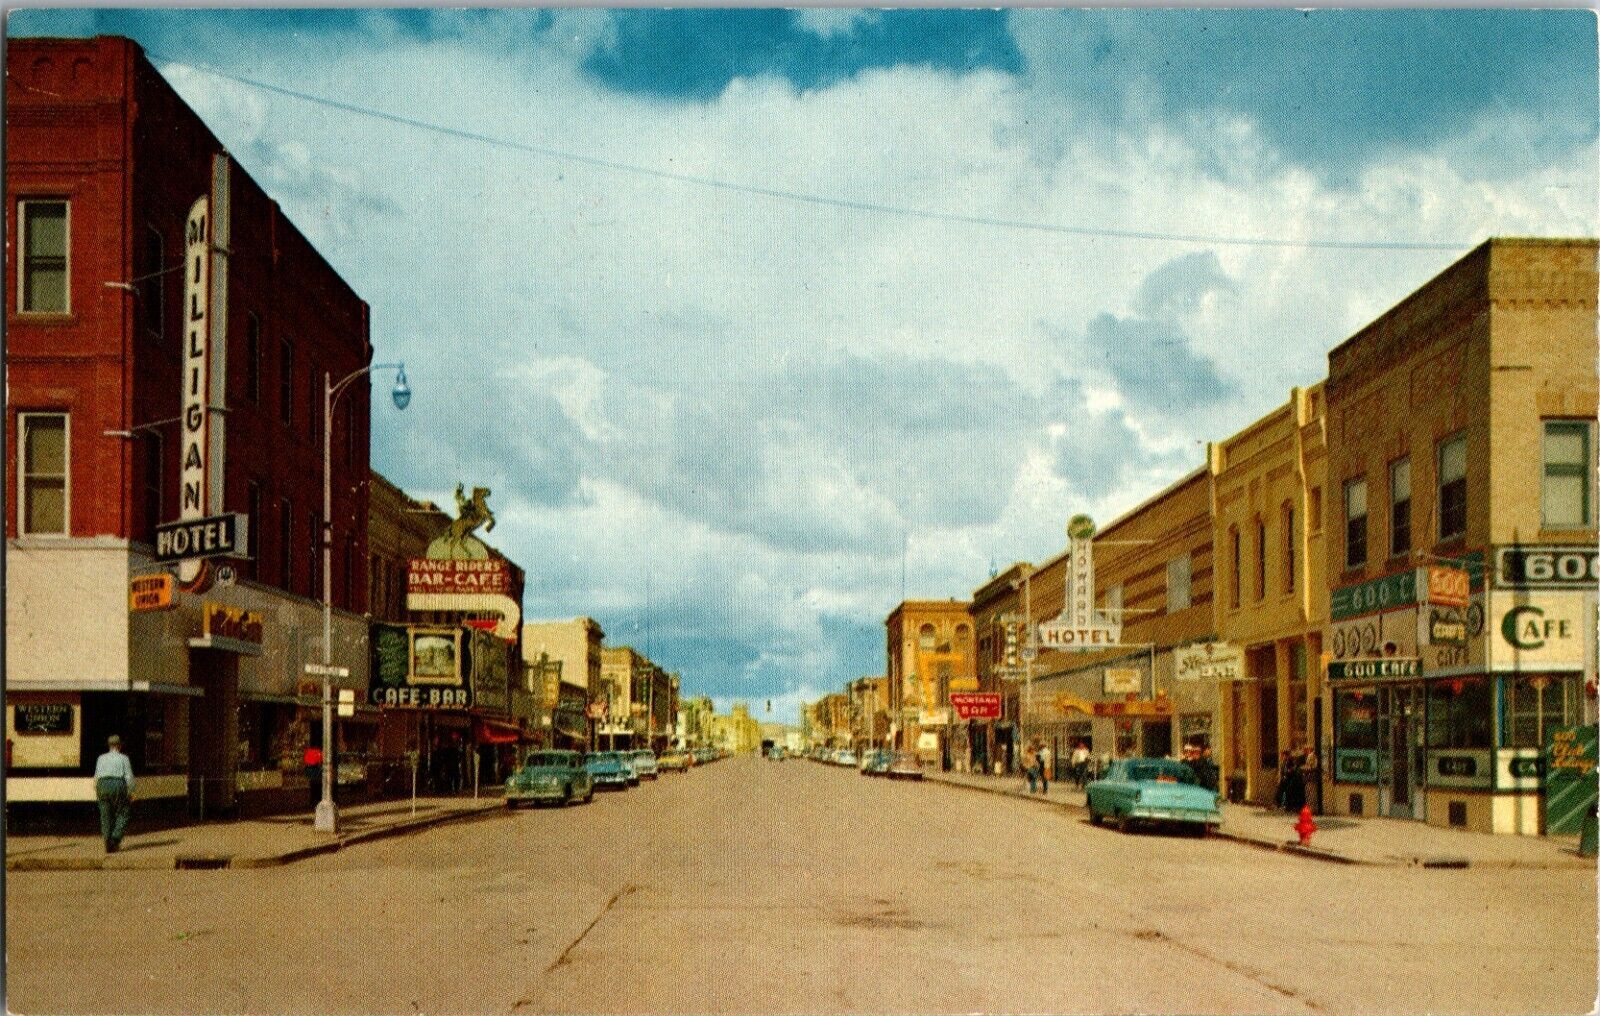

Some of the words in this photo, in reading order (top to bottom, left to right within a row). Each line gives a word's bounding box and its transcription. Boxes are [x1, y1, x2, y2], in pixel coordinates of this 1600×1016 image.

[184, 214, 206, 511] MILLIGAN
[157, 521, 231, 556] HOTEL
[411, 561, 452, 571] RANGE
[456, 561, 500, 571] RIDERS
[1048, 629, 1114, 643] HOTEL
[1501, 606, 1571, 650] CAFE
[1344, 663, 1375, 677] 600
[1381, 661, 1418, 676] CAFE
[961, 706, 988, 714] BAR
